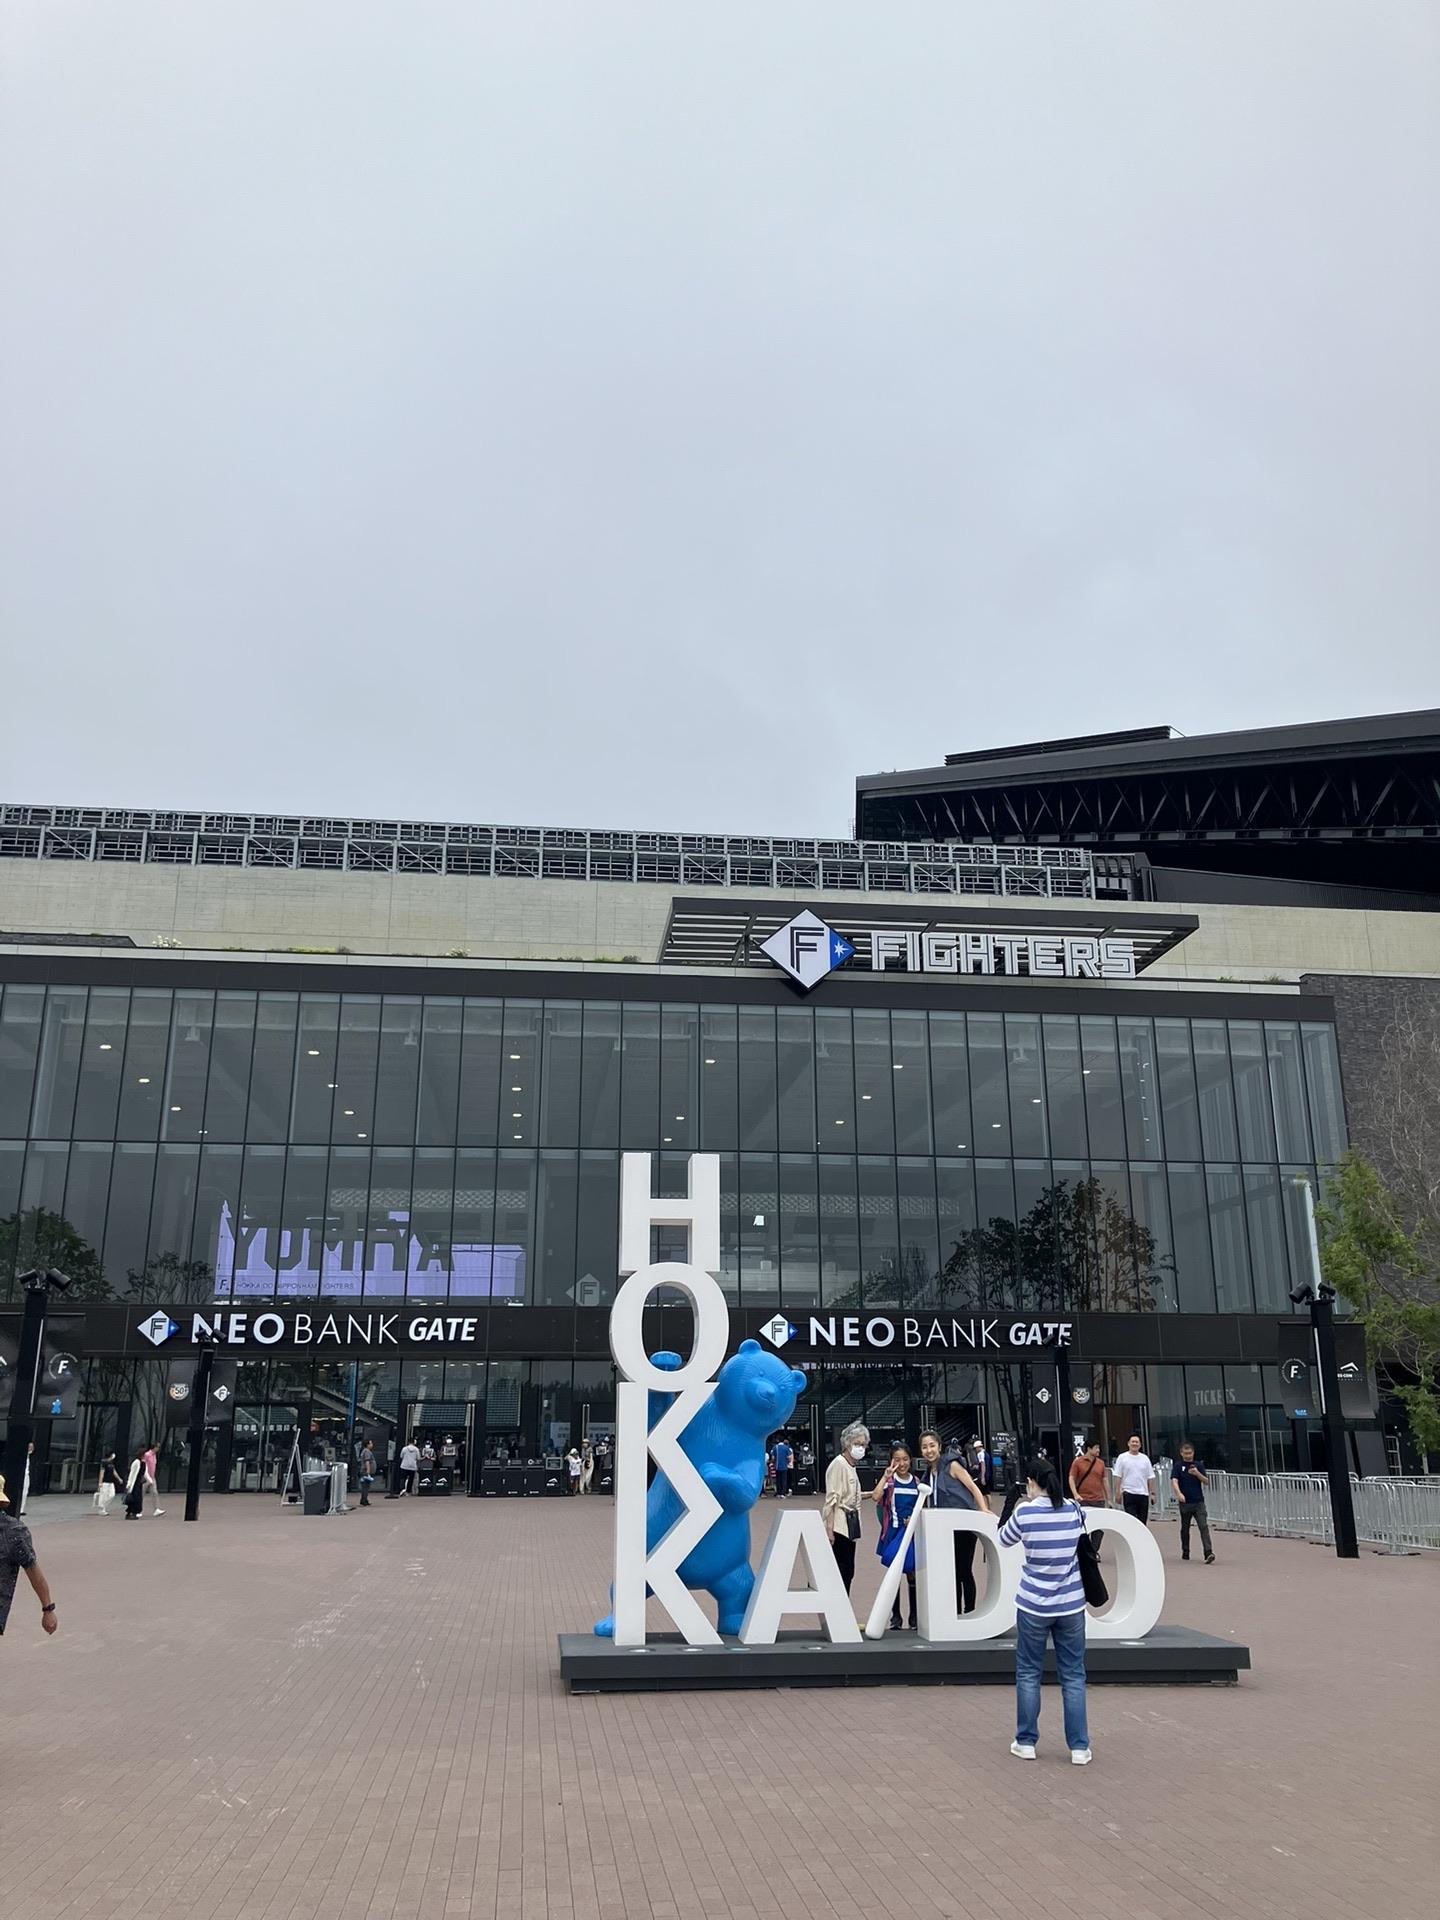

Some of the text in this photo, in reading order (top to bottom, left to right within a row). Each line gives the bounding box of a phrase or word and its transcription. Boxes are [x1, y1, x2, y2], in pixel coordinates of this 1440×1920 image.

[871, 931, 1137, 978] FIGHTERS
[191, 1312, 285, 1344] NEO
[294, 1313, 399, 1344] BANK
[408, 1317, 478, 1342] GATE
[809, 1316, 896, 1348] NEO
[904, 1318, 1001, 1348] BANK
[1009, 1322, 1073, 1346] GATE
[1193, 1388, 1236, 1406] TICKETS
